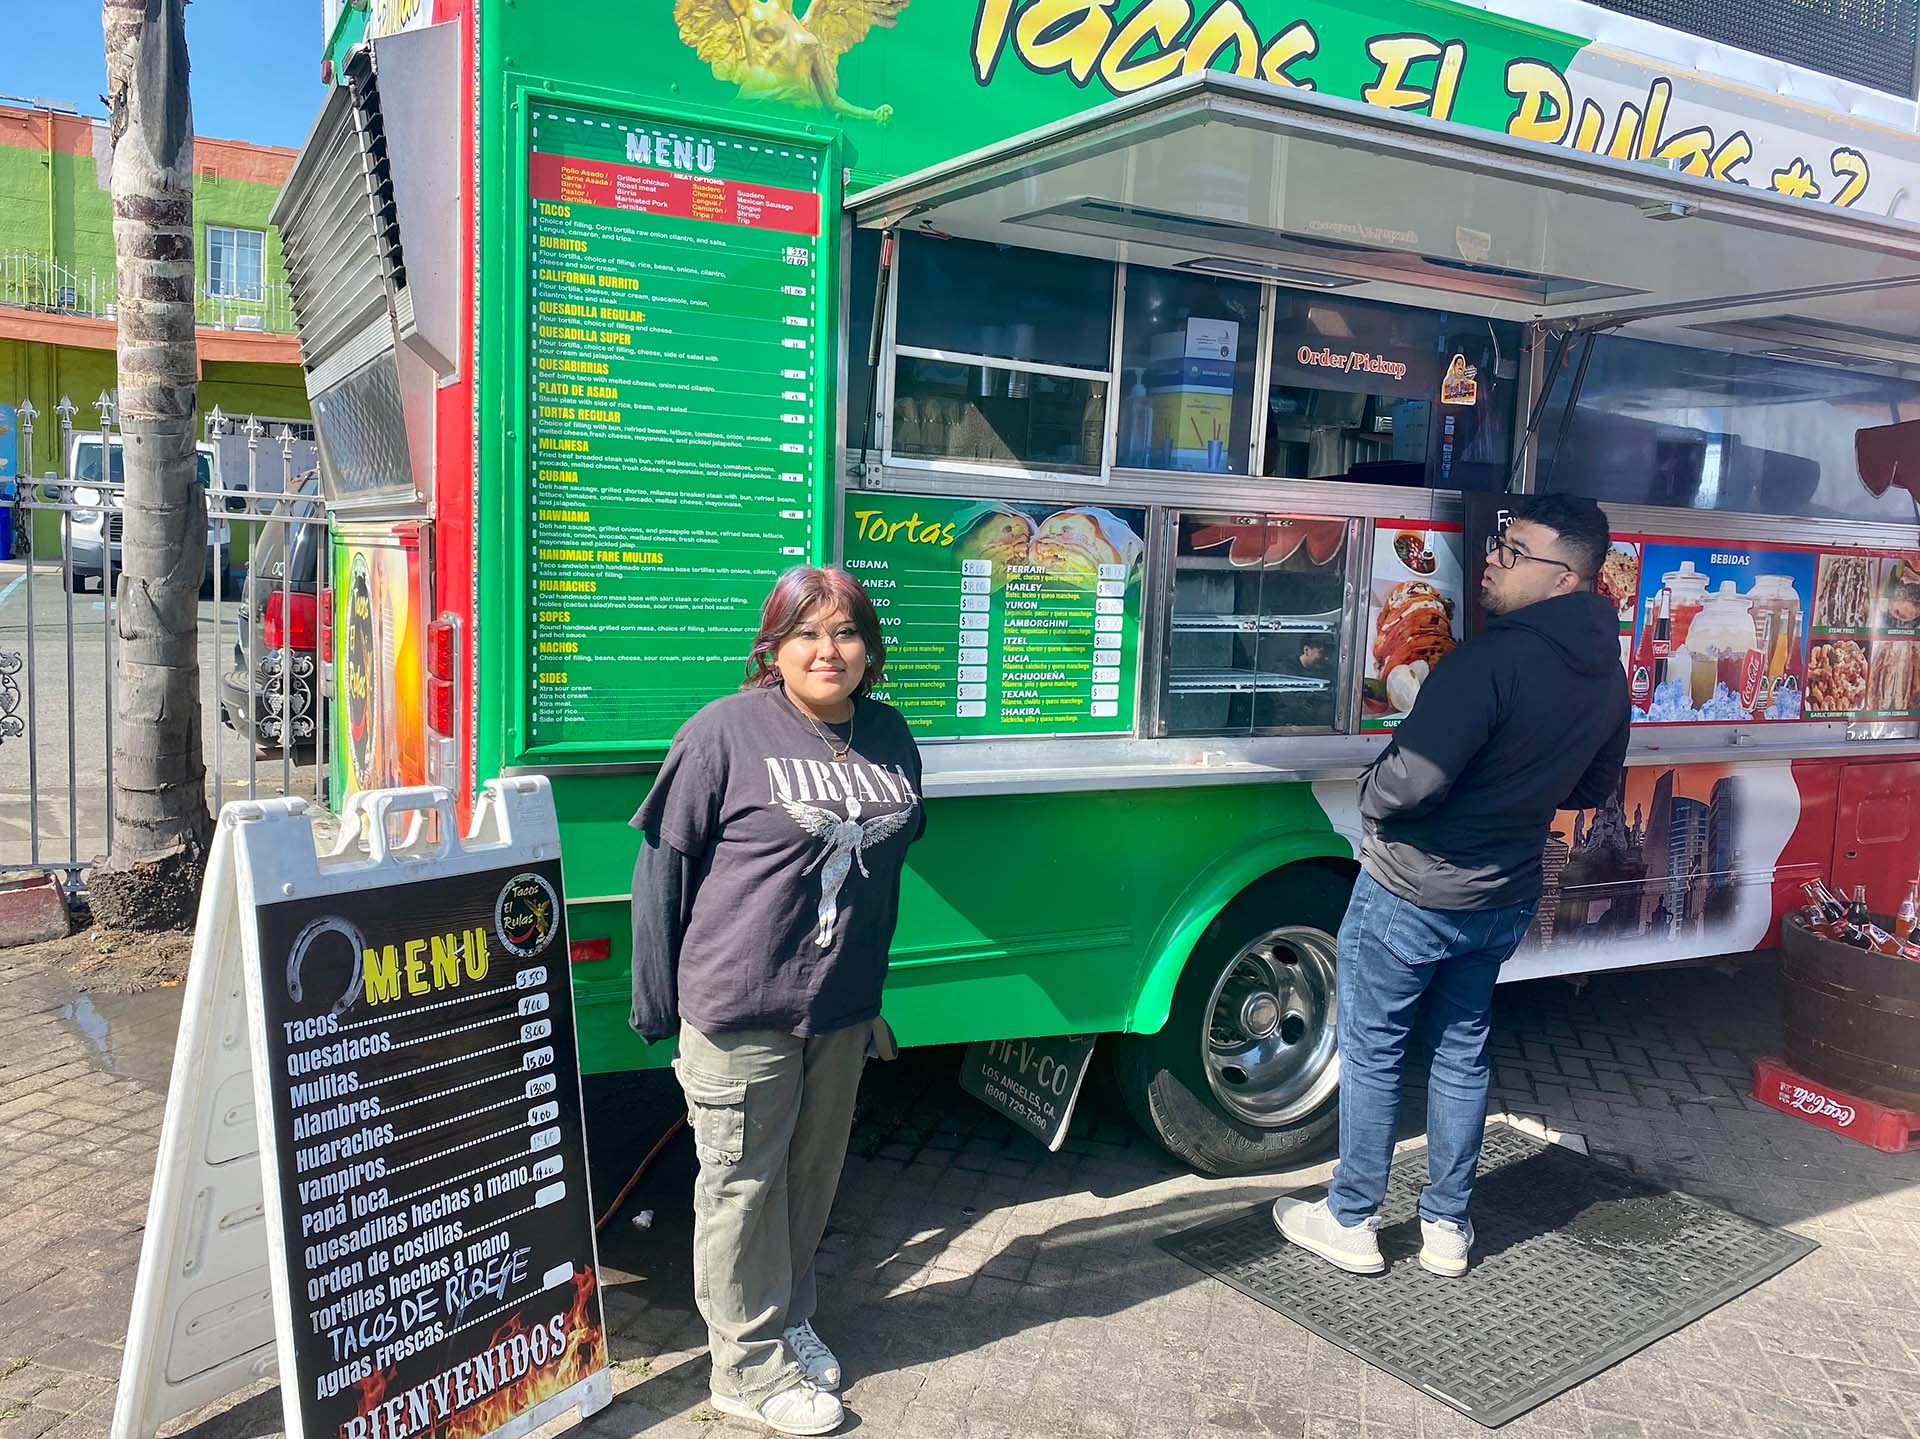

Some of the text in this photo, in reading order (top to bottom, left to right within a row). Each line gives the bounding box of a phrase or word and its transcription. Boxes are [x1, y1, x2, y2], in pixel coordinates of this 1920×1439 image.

[1361, 32, 1466, 121] El
[626, 132, 716, 173] MENU
[561, 166, 604, 178] Pollo Asado
[674, 172, 692, 181] MEAT
[561, 174, 609, 186] Carne Asada
[561, 180, 582, 190] Birria
[616, 174, 670, 188] Grilled chicken
[616, 180, 657, 193] Roast meat
[561, 188, 585, 196] Pastor
[616, 188, 637, 197] Birria
[692, 183, 721, 194] Suadero
[736, 190, 765, 200] Suadero
[560, 195, 592, 205] Carnitas
[614, 194, 668, 208] Marinated Pork
[616, 202, 647, 212] Carnitas
[692, 197, 718, 208] Lengua
[736, 196, 794, 211] Mexican Sausage
[539, 202, 571, 218] TACOS
[692, 210, 710, 220] Tripa
[736, 203, 762, 213] Tongue
[736, 210, 761, 220] Shrimp
[736, 216, 751, 225] Trip
[539, 216, 563, 226] Choice
[596, 224, 612, 232] Corn
[613, 226, 635, 236] tortilla
[650, 232, 668, 240] onion
[539, 235, 588, 253] BURRITOS
[539, 268, 640, 290] CALIFORNIA BURRITO
[539, 301, 646, 323] QUESADILLA REGULAR:
[584, 320, 606, 328] choice
[616, 322, 634, 331] filling
[539, 325, 631, 346] QUESADILLA SUPER
[539, 358, 609, 375] QUESABIRRIAS
[1297, 345, 1407, 382] Order/Pickup
[539, 382, 618, 400] PLATO DE ASADA
[539, 406, 621, 423] TORTAS REGULAR
[539, 438, 589, 452] MILANESA
[539, 470, 579, 483] CUBANA
[539, 509, 590, 523] HAWAIANA
[854, 510, 956, 546] Tortas
[539, 548, 664, 564] HANDMADE FARE MULITAS
[1710, 553, 1750, 566] BEBIDAS
[846, 560, 889, 569] CUBANA
[1006, 565, 1046, 574] FERRARI
[539, 580, 597, 592] HUARACHES
[862, 580, 896, 588] ANESA
[1006, 583, 1042, 592] HARLEY
[539, 611, 571, 623] SOPES
[1004, 619, 1068, 628] LAMBORGHINI
[539, 642, 579, 653] NACHOS
[539, 672, 568, 684] SIDES
[1002, 671, 1066, 680] PACHUQUEÑA
[1001, 690, 1038, 698] TEXANA
[1000, 708, 1041, 716] SHAKIRA
[763, 757, 918, 806] NIRVANA
[512, 885, 539, 898] Tacos
[504, 901, 513, 913] El
[504, 914, 533, 930] Rulas
[362, 927, 490, 1006] MENU
[283, 1012, 338, 1045] Tacos
[287, 1032, 391, 1077] Quesatacos
[290, 1071, 359, 1109] Mulitas
[982, 1064, 1000, 1081] LOS
[1000, 1075, 1041, 1112] ANGELES,
[985, 1082, 1046, 1130] (800) 729-7390
[1789, 1086, 1856, 1127] Coca-Cola
[293, 1096, 380, 1142] Alambres
[296, 1123, 394, 1173] Huaraches
[298, 1157, 386, 1205] Vampiros
[302, 1187, 390, 1238] Papá loca
[305, 1166, 528, 1270] Quesadillas hechas a mano
[307, 1221, 463, 1302] Orden de costillas
[310, 1231, 510, 1335] Tortillas hechas a mano
[327, 1307, 398, 1362] TACOS
[401, 1288, 440, 1332] DE
[317, 1321, 444, 1400] Aguas Frescas
[344, 1312, 568, 1439] BIENVENIDOS
